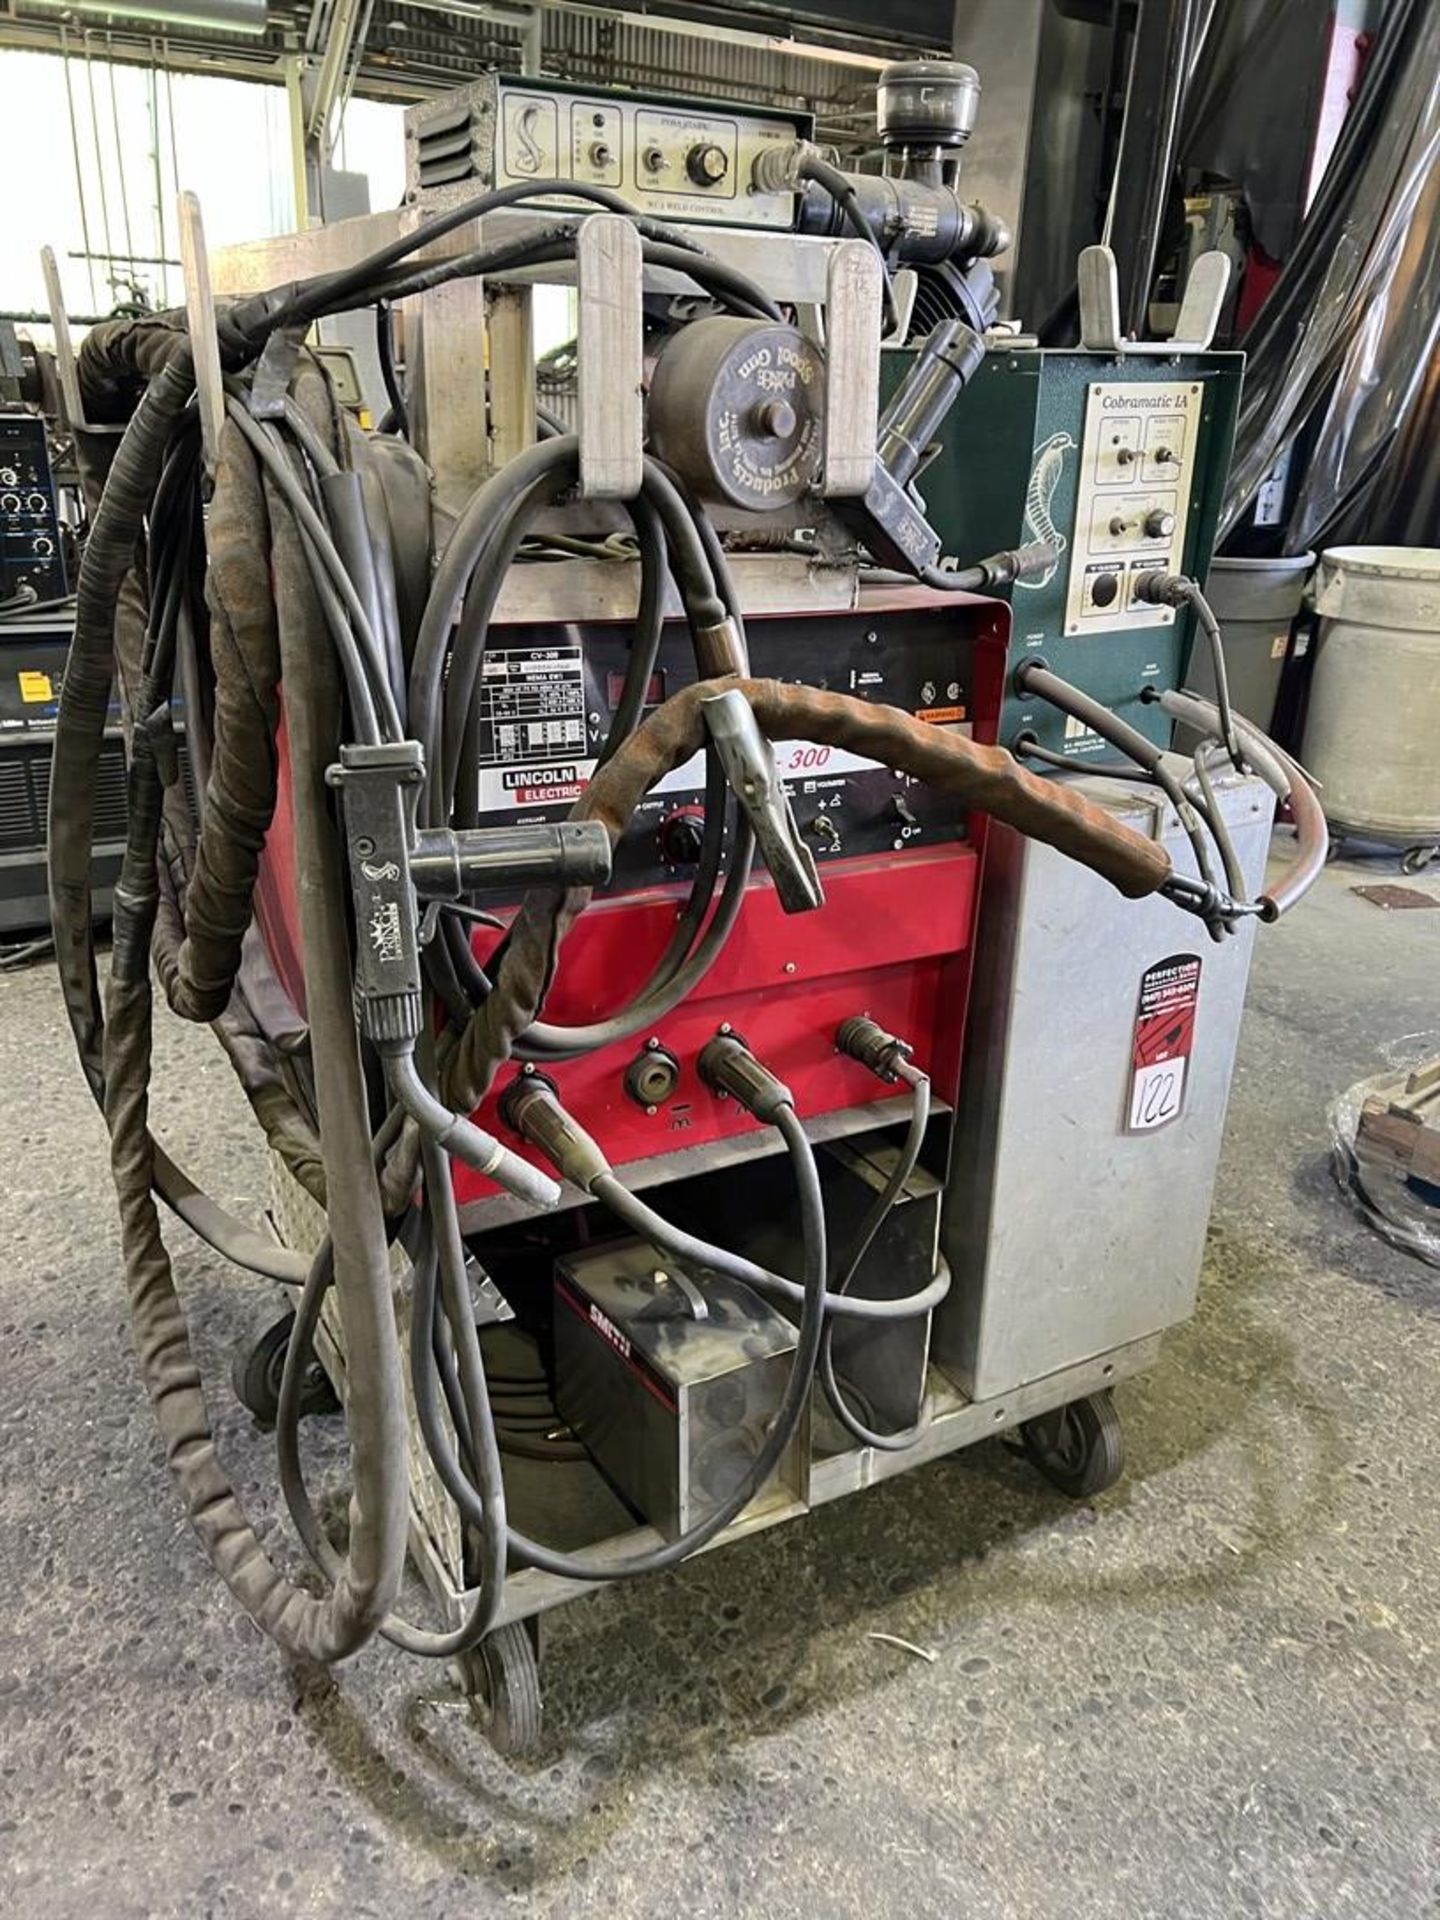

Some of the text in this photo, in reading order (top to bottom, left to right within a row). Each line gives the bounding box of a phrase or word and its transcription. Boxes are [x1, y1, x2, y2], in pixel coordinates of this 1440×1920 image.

[738, 347, 814, 384] Spool Gun
[1102, 395, 1172, 409] Cobramatic
[788, 747, 831, 770] 300
[506, 769, 575, 788] LINCOLN
[525, 785, 582, 800] ELECTRIC
[1145, 961, 1198, 982] PERFECTION
[1137, 1073, 1174, 1125] 122
